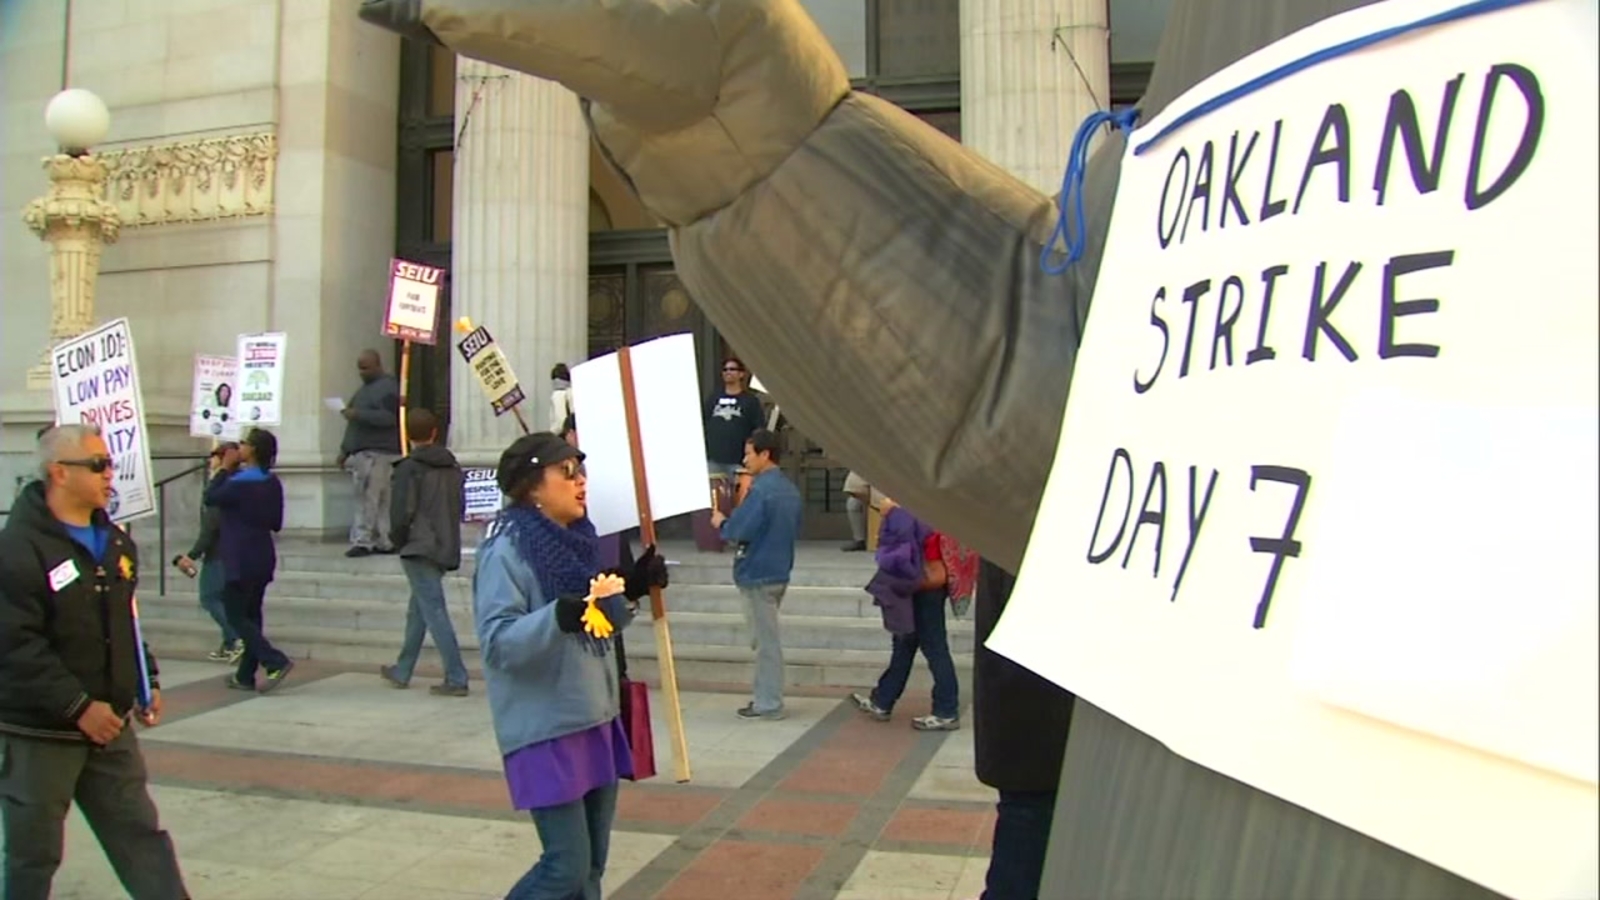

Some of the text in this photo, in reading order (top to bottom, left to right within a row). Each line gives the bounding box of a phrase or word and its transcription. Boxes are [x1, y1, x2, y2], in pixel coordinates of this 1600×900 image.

[1157, 63, 1546, 249] OAKLAND
[394, 261, 440, 284] SEIU
[1133, 249, 1456, 395] STRIKE
[56, 340, 96, 379] ECON
[461, 326, 488, 358] SEIU
[67, 364, 131, 406] LOW PAY
[80, 399, 134, 428] DRIVES
[466, 469, 498, 480] SEIU
[1087, 447, 1313, 630] DAY 7
